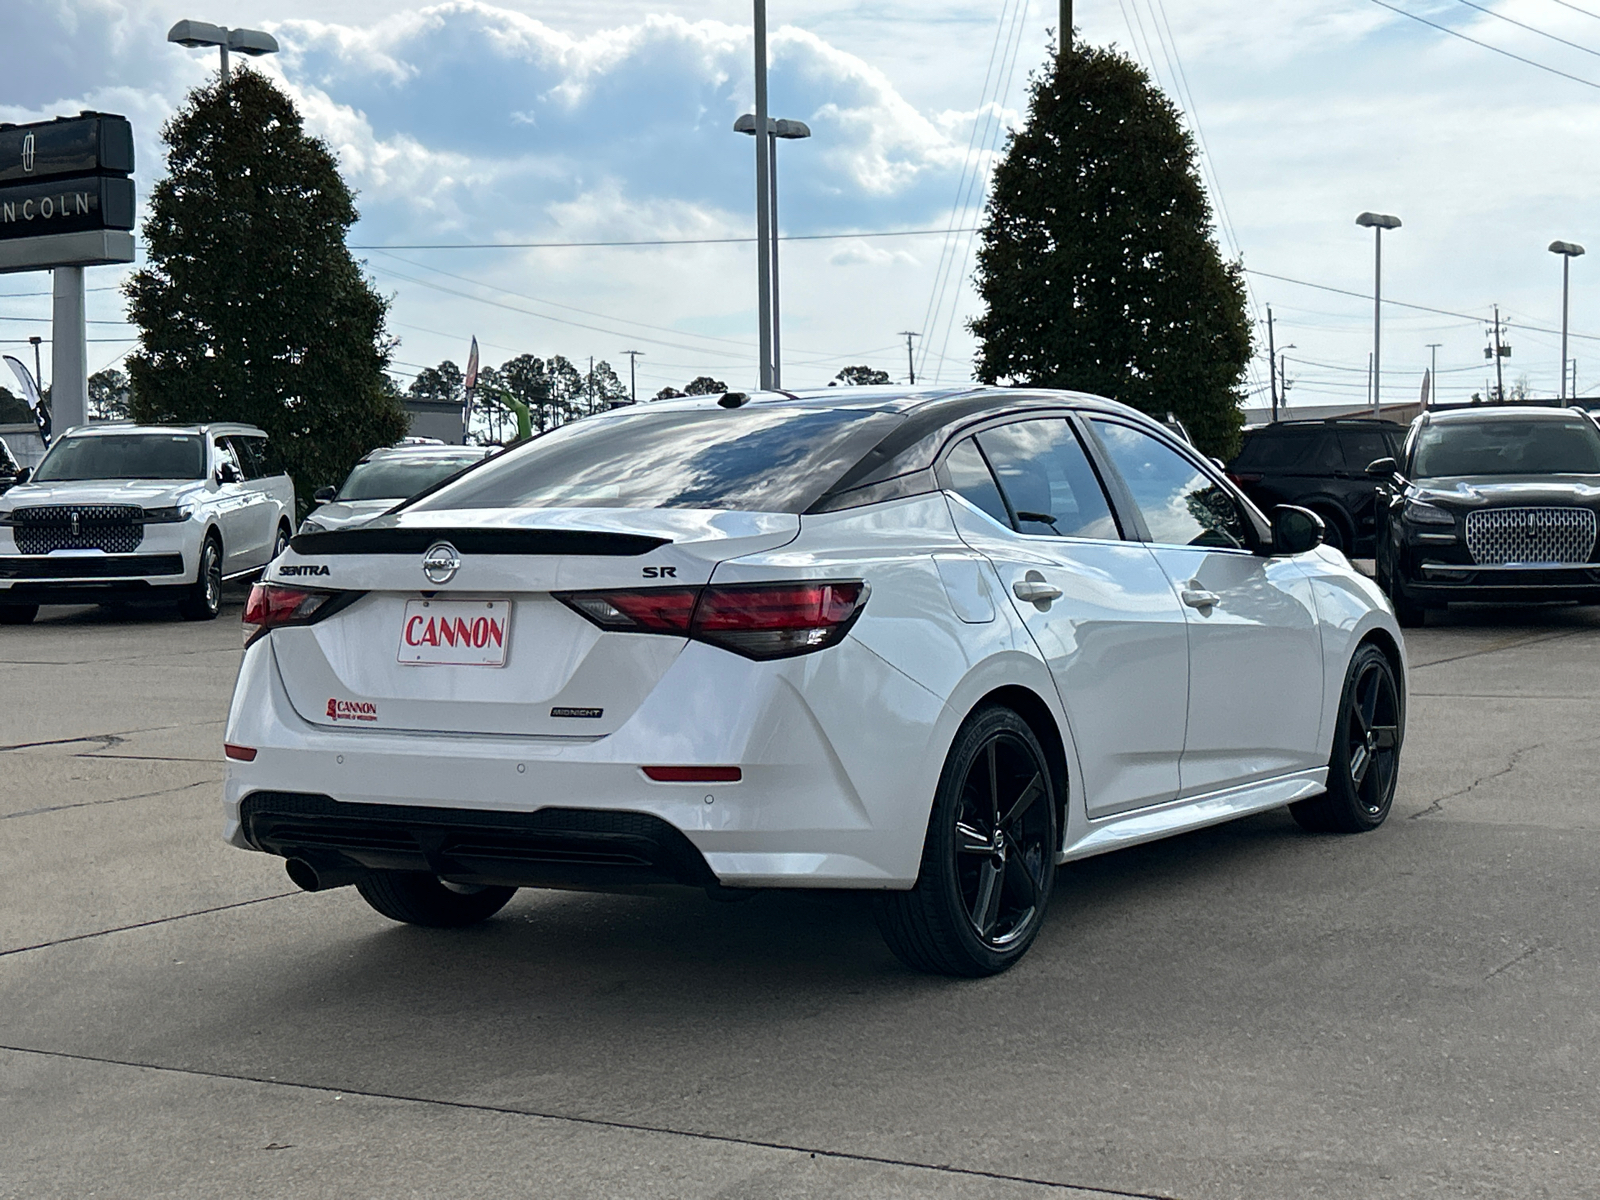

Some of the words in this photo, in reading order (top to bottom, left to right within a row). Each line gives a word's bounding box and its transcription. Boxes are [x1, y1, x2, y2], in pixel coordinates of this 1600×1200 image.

[3, 192, 89, 223] NCOLN
[279, 565, 331, 576] SENTRA
[642, 566, 677, 578] SR
[405, 615, 505, 648] CANNON
[337, 700, 377, 714] CANNON
